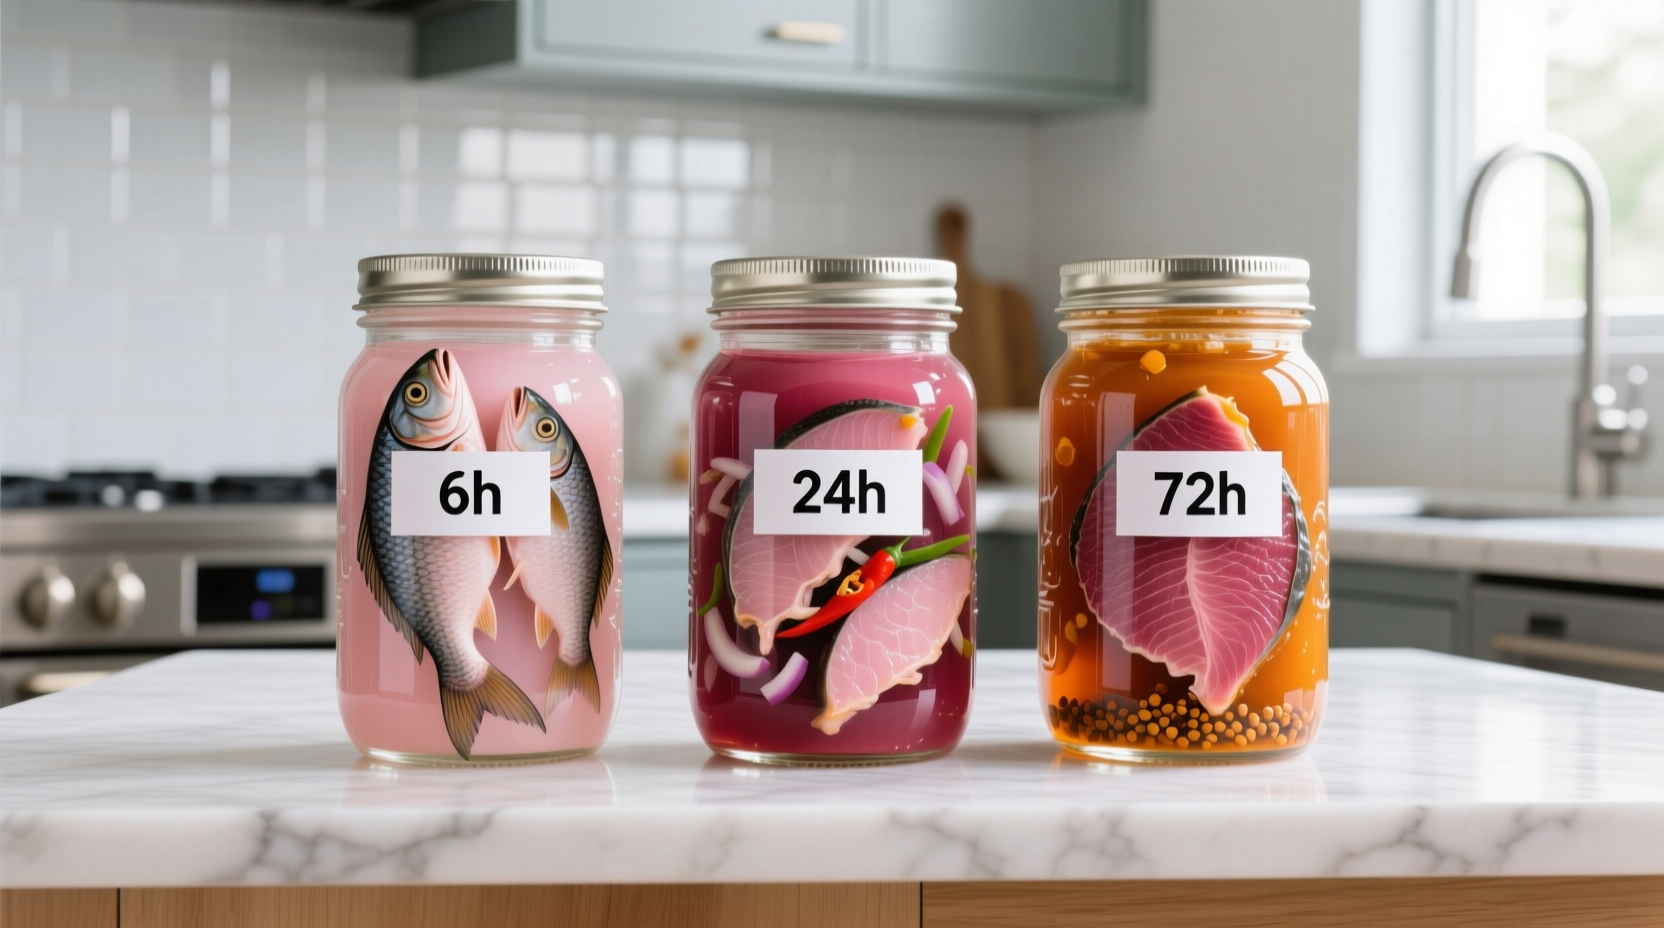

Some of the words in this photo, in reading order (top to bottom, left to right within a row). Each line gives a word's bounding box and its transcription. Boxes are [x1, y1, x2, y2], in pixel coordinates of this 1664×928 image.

[440, 470, 501, 515] 6h
[793, 469, 886, 514] 24h
[1154, 470, 1246, 516] 72h
